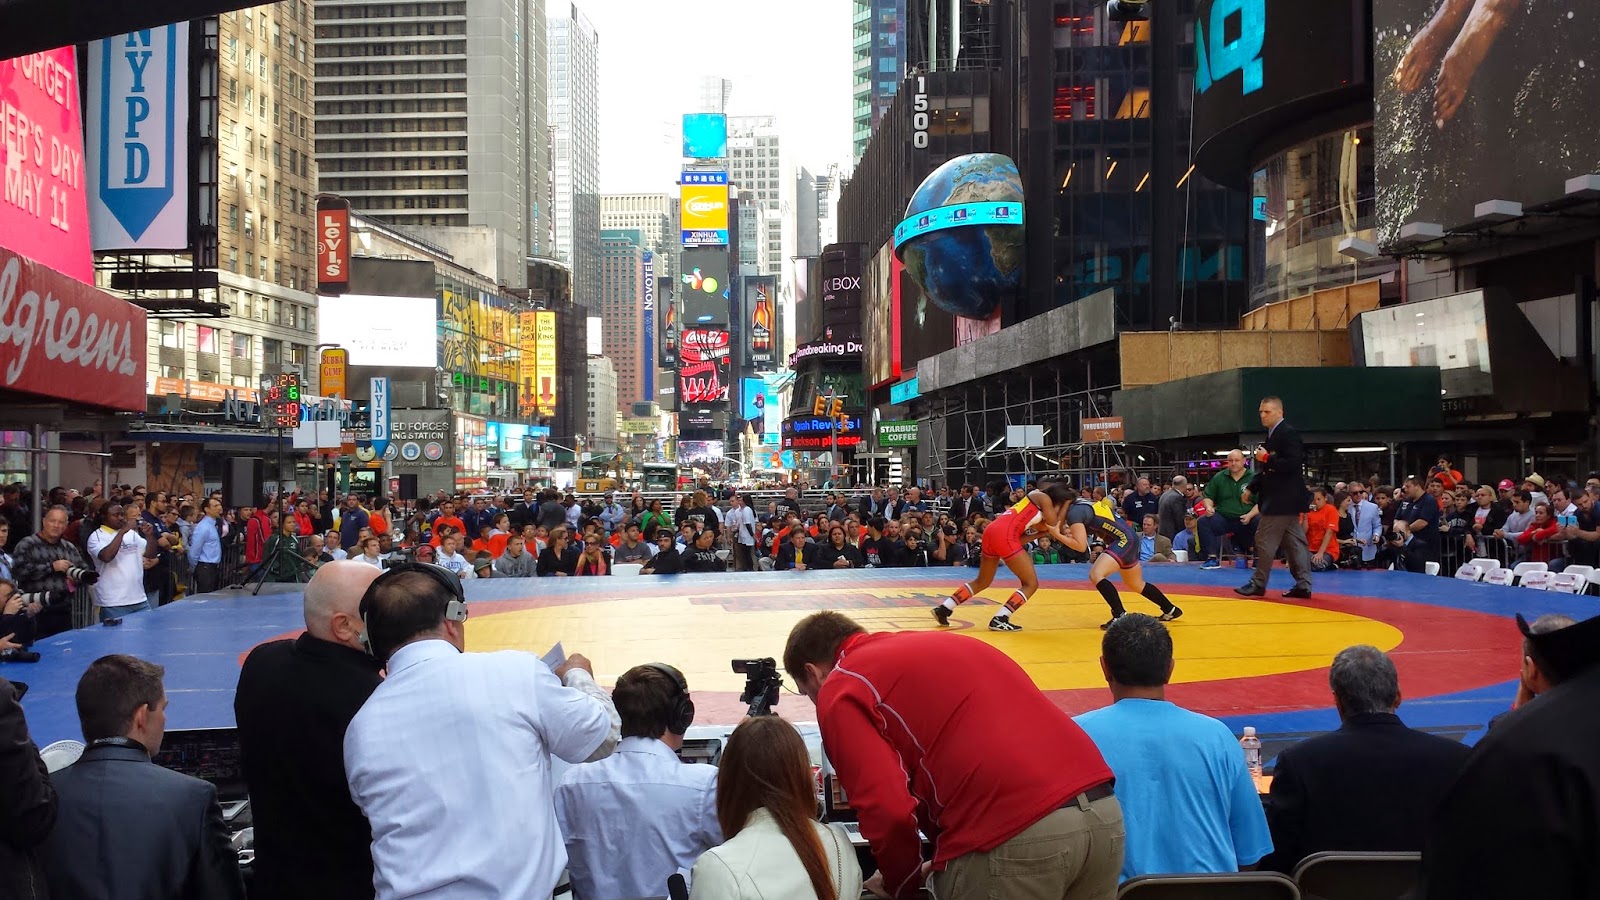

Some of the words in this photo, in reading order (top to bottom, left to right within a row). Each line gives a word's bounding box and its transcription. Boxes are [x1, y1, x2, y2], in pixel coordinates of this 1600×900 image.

[914, 77, 928, 148] 1500
[51, 135, 80, 190] DAY
[5, 164, 43, 218] MAY
[51, 185, 69, 232] 11
[644, 258, 653, 311] NOVOTEL
[833, 277, 860, 290] BOX
[323, 355, 344, 364] BUBBA
[324, 367, 342, 376] GUMP
[289, 387, 298, 399] 6
[375, 380, 383, 437] NYPD
[408, 422, 449, 431] FORCES
[812, 419, 854, 430] Revas
[1083, 422, 1121, 430] TROUBLESHOOT
[408, 432, 444, 440] STATION
[822, 436, 861, 447] plase
[586, 482, 598, 490] CAT
